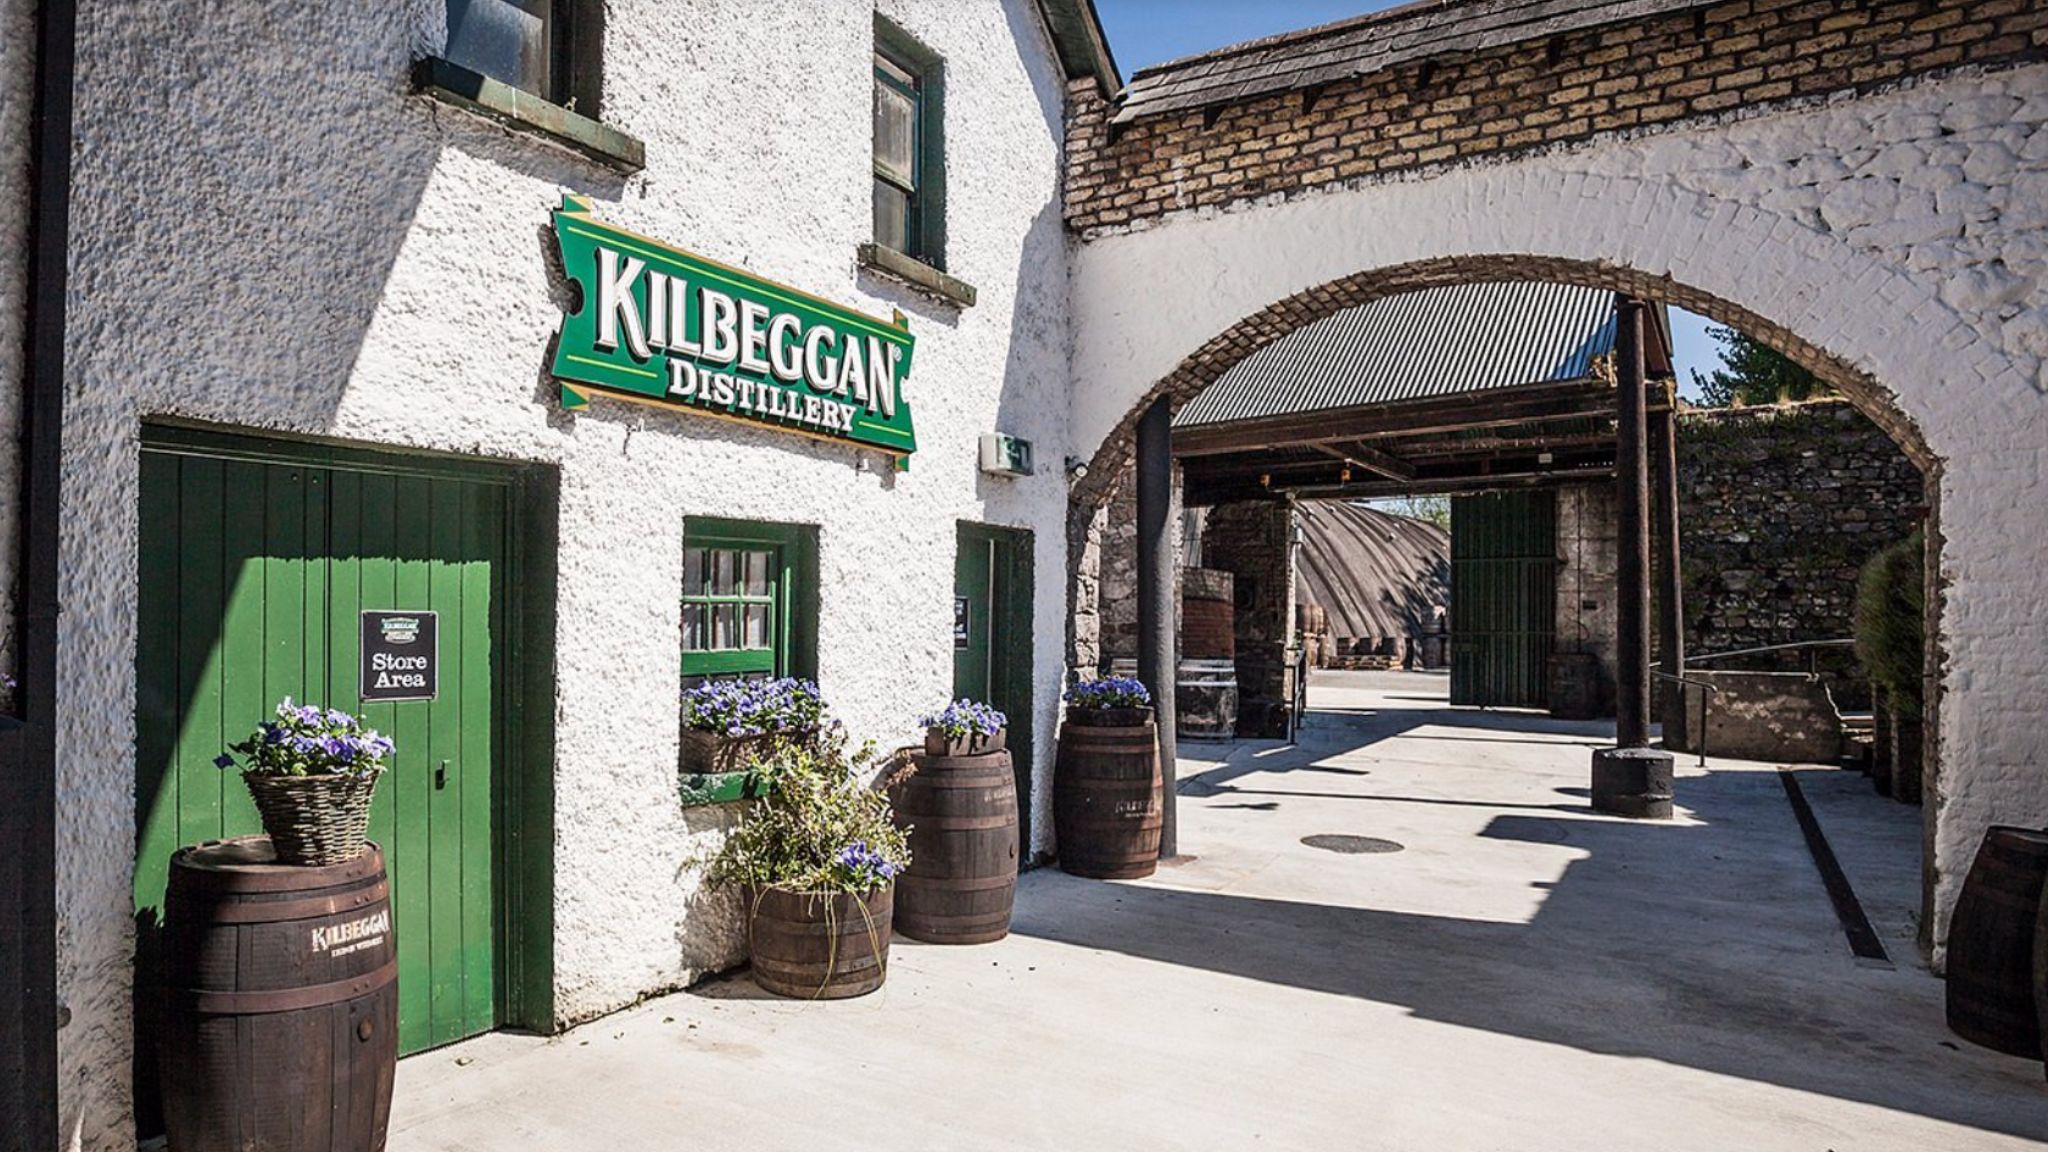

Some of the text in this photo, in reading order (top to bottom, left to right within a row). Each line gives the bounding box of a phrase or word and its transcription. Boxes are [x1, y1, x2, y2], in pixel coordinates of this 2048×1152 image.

[596, 246, 896, 416] KILBEGGAN
[668, 358, 857, 431] DISTILLERY
[372, 652, 428, 671] Store
[373, 671, 427, 689] Area
